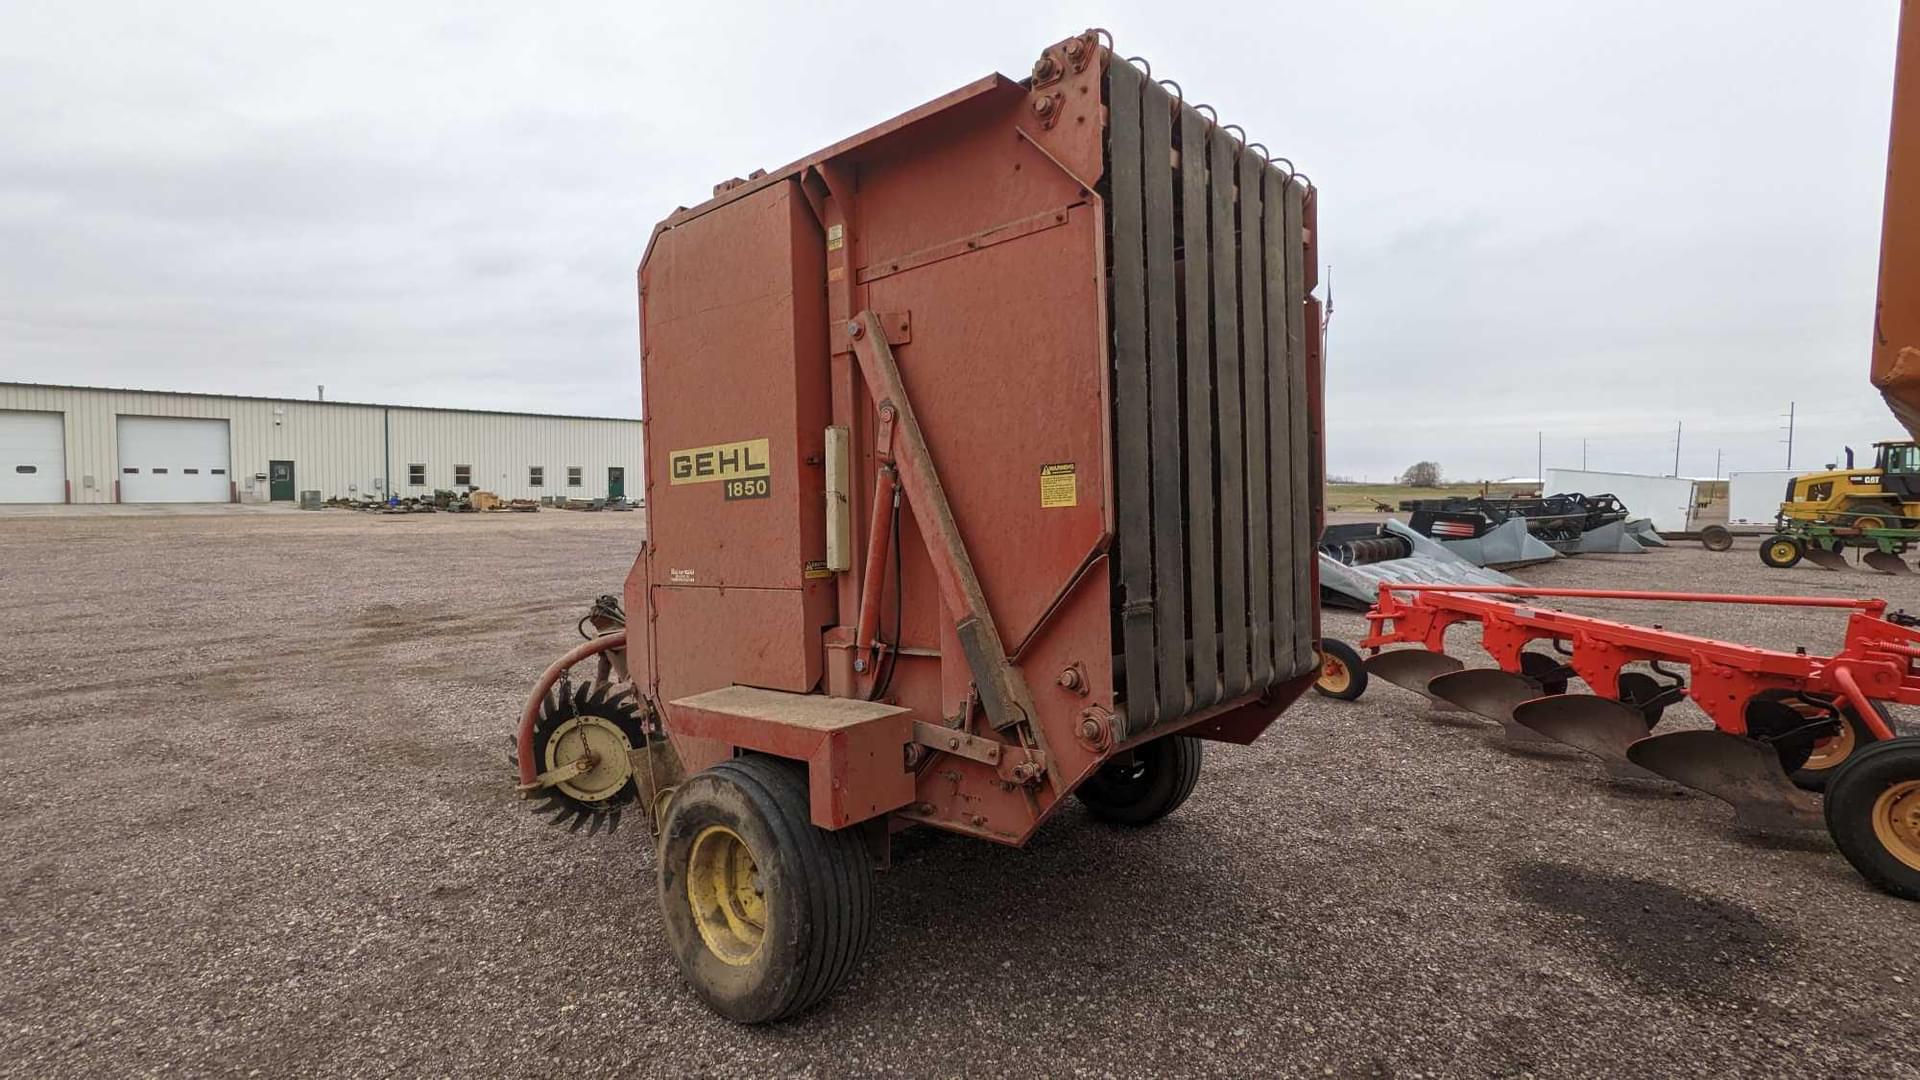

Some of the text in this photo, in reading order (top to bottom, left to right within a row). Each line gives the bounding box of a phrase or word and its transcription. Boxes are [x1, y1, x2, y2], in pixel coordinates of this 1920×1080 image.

[673, 447, 766, 479] GEHL
[727, 480, 767, 497] 1850
[1864, 476, 1881, 484] CAT
